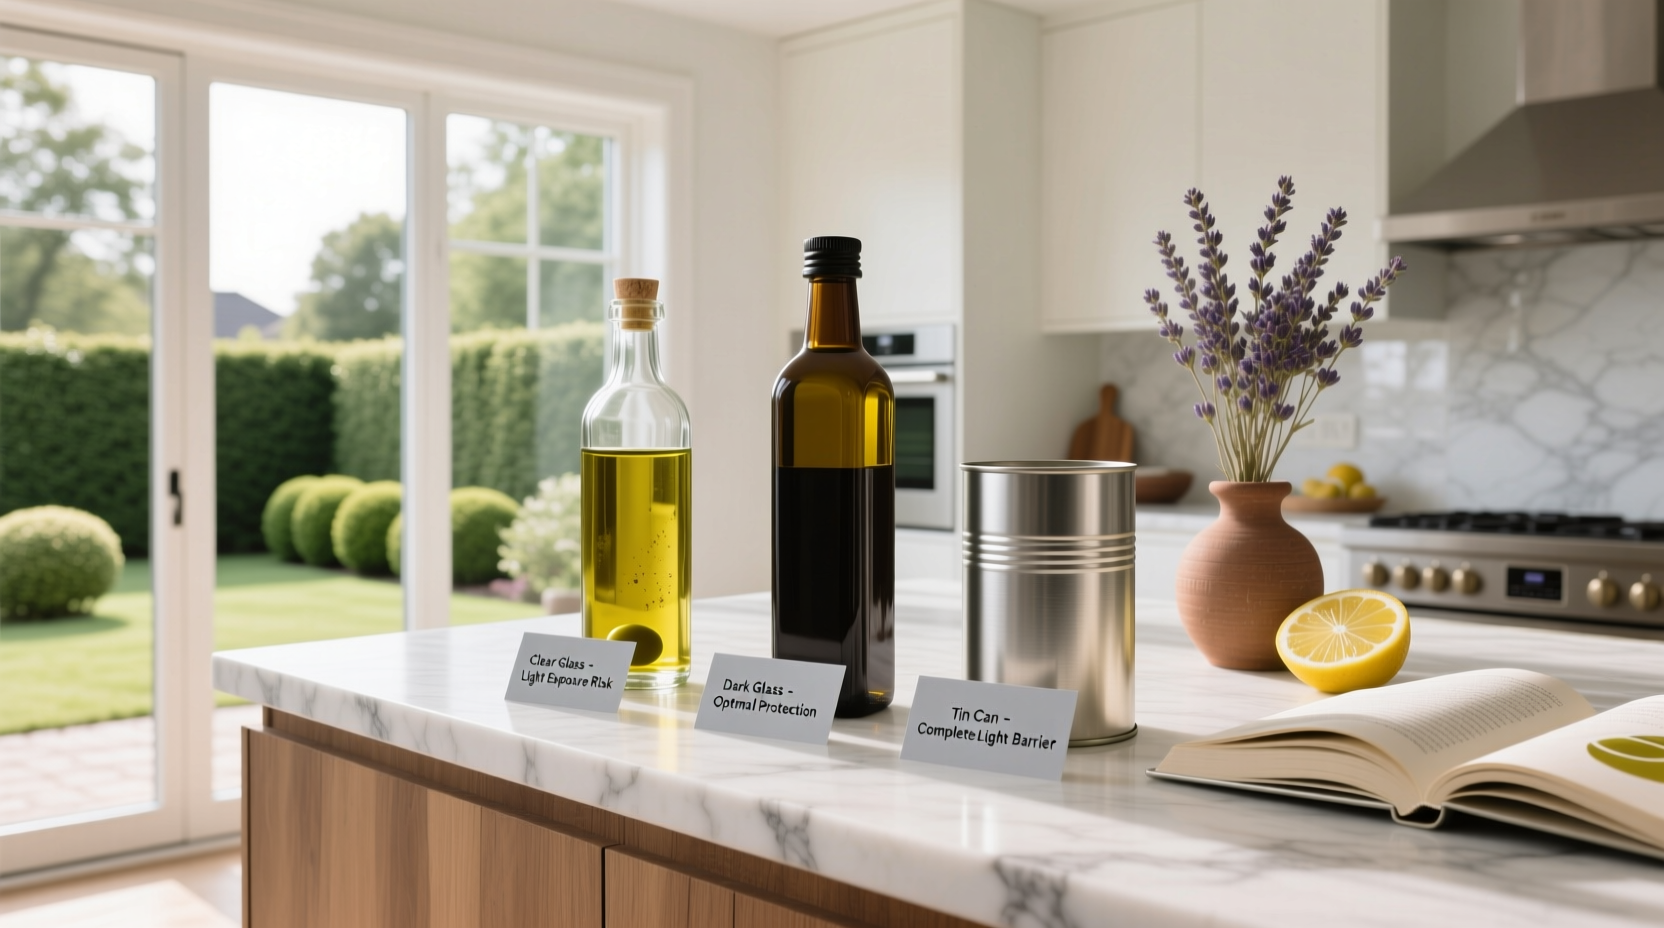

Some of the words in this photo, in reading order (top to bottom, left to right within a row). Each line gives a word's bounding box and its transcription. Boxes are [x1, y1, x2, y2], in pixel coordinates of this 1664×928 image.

[530, 654, 557, 668] Clear
[723, 678, 750, 693] Dark
[752, 681, 784, 695] Glass
[759, 699, 817, 718] Protection
[952, 707, 970, 721] Tin
[973, 709, 999, 724] Can
[917, 722, 976, 741] Complete
[976, 729, 1009, 747] Light
[1011, 732, 1057, 750] Barrier
